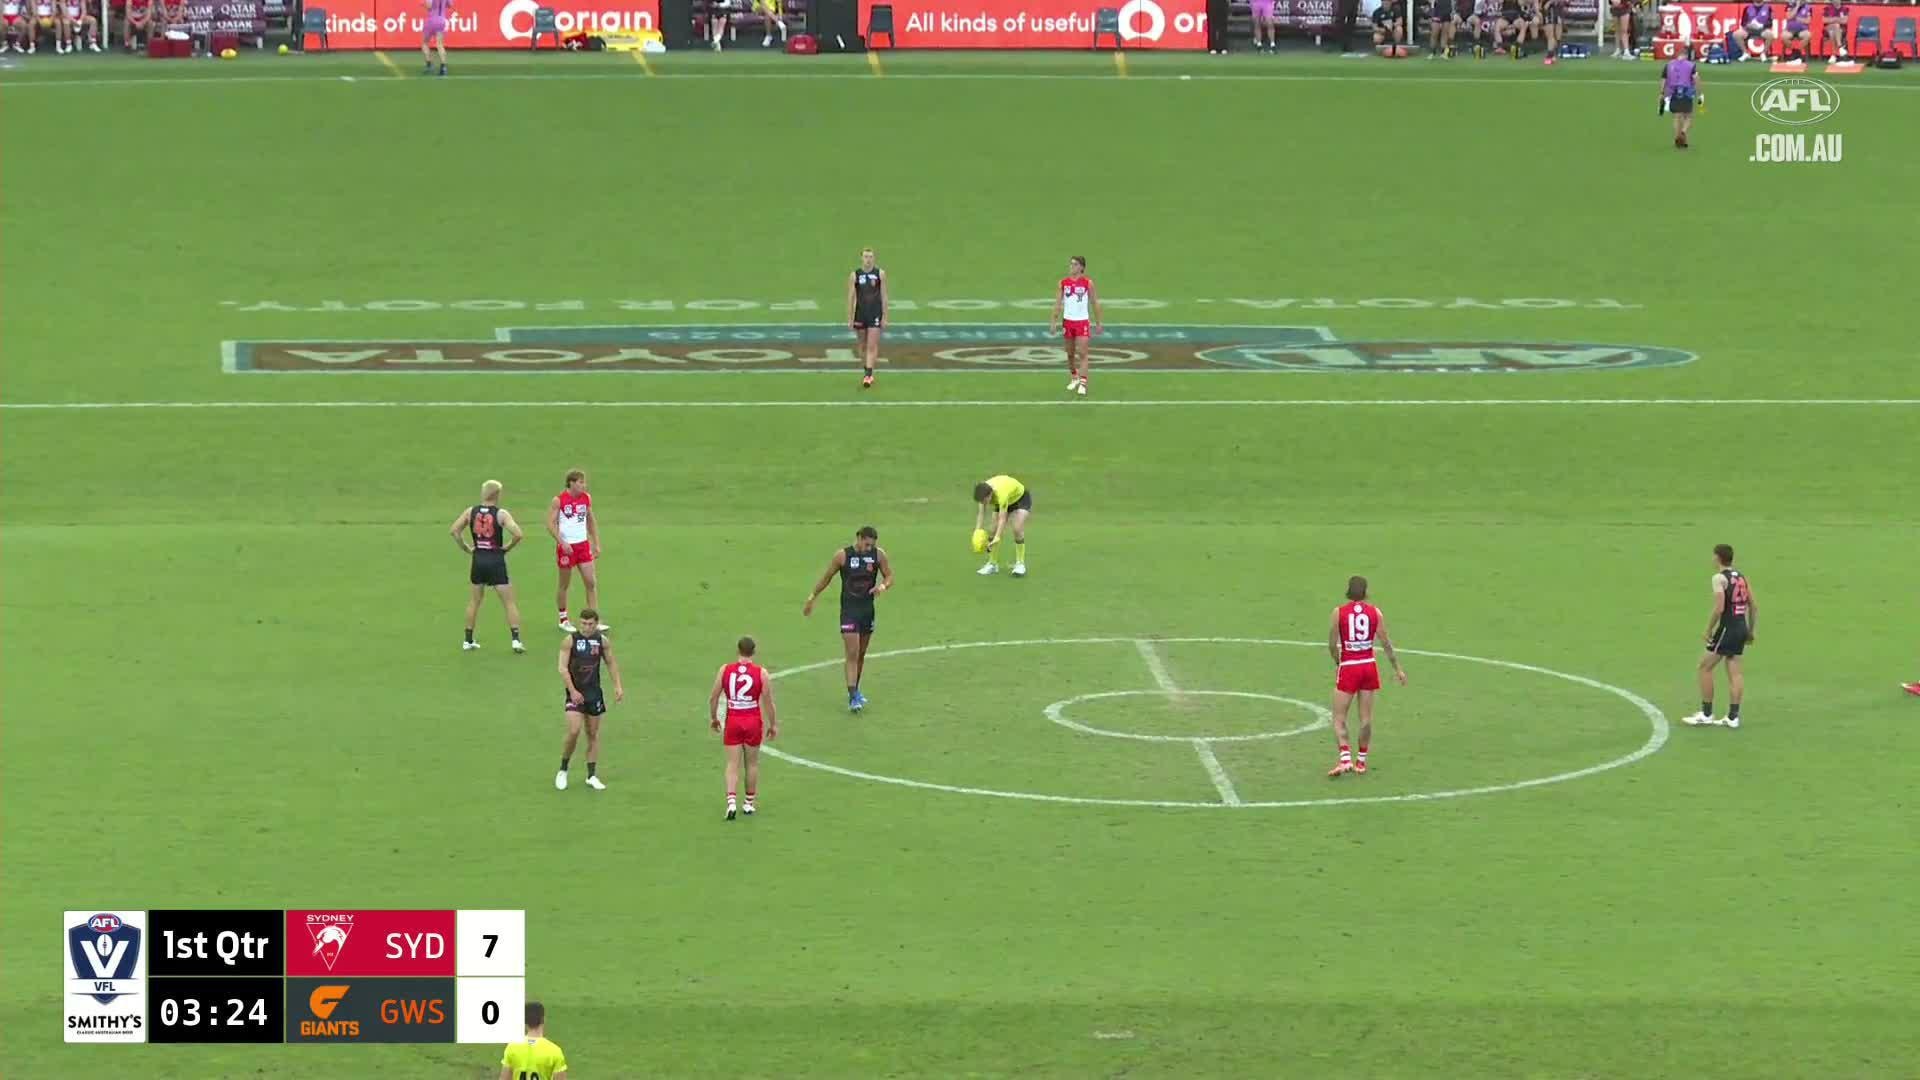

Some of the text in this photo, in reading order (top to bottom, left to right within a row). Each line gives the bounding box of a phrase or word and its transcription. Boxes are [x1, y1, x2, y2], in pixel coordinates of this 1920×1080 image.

[186, 5, 213, 17] ATAR
[220, 3, 256, 15] QATAR
[383, 11, 407, 32] of
[411, 11, 478, 32] uful
[554, 10, 652, 33] origin
[905, 11, 1095, 32] All kinds of useful
[221, 298, 584, 312] FOOTY.
[616, 298, 819, 311] FOR
[1196, 297, 1645, 310] TOYOTA.
[646, 331, 1187, 342] PREIERSHP 2025
[283, 347, 1638, 366] AFL TOYOTA
[1348, 613, 1370, 643] 19
[728, 672, 754, 702] 12
